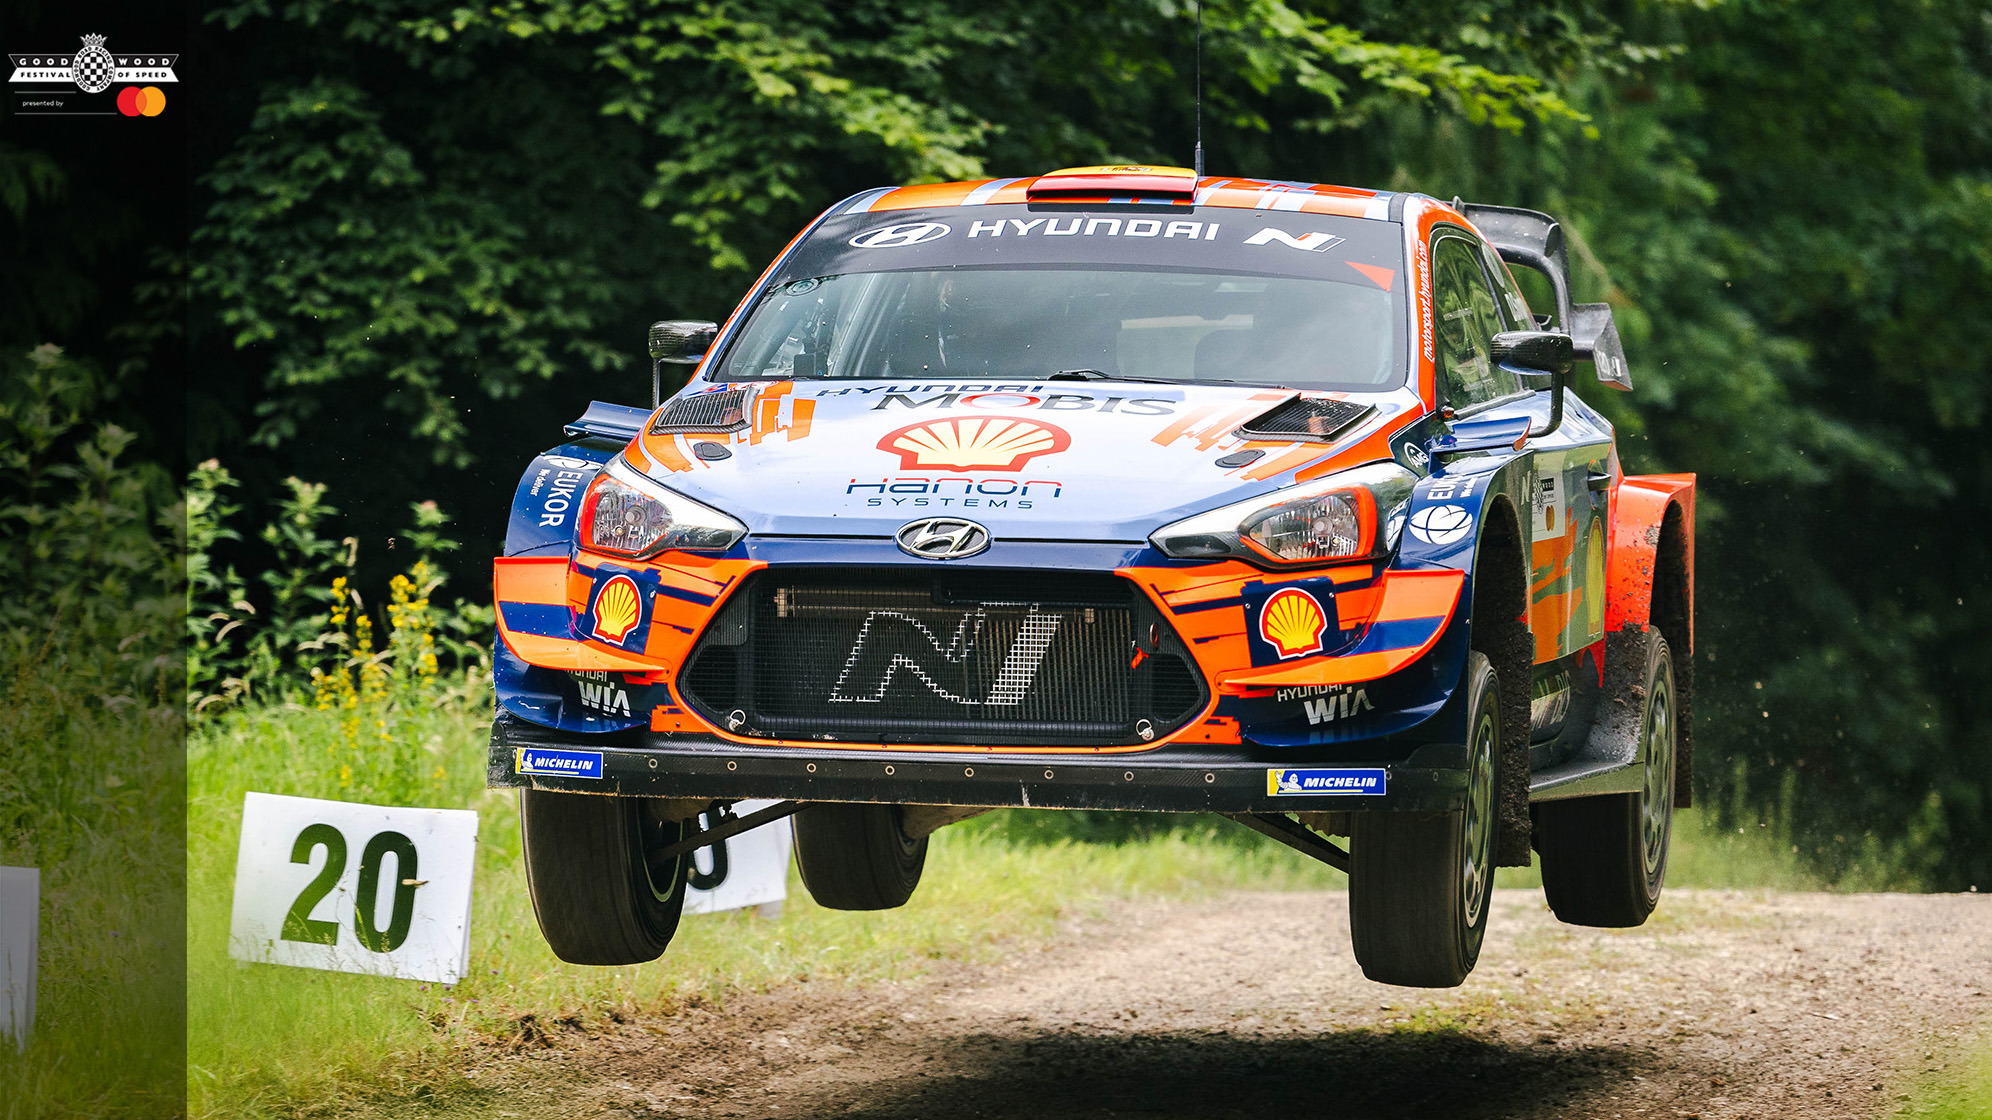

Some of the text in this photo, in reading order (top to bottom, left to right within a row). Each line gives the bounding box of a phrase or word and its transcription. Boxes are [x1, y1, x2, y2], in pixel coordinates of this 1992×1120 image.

[967, 218, 1220, 241] HYUNDAI
[815, 385, 1043, 397] HYUNDAI
[869, 392, 1177, 416] MOBIS
[539, 470, 584, 528] EUKOR
[867, 498, 1033, 509] SYSTEMS
[534, 756, 594, 770] MICHELIN
[1303, 777, 1377, 788] MICHELIN
[280, 823, 419, 954] 20
